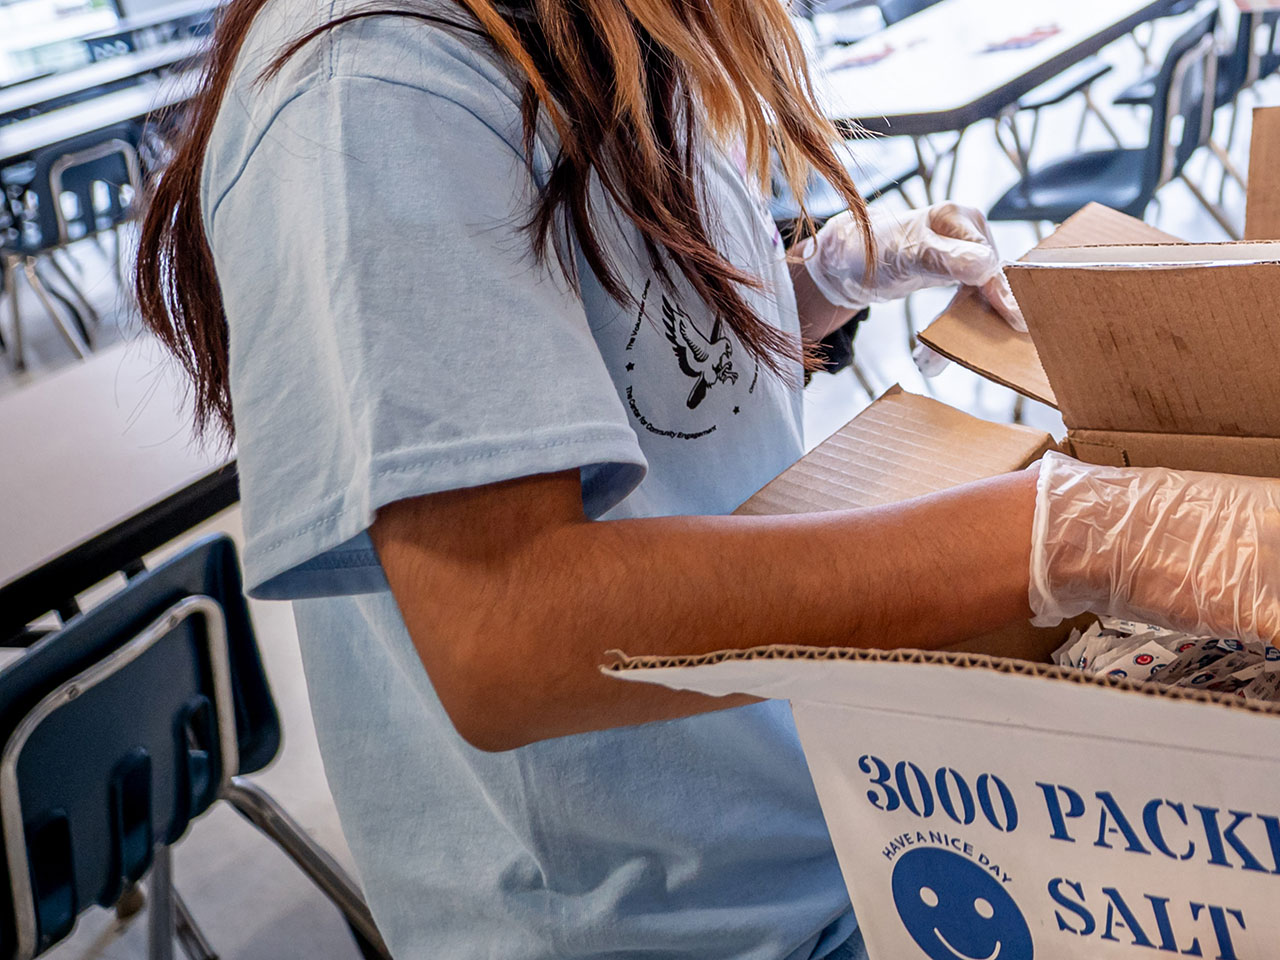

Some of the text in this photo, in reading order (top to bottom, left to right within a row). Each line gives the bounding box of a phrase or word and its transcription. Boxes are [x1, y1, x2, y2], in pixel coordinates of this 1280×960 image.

[626, 336, 636, 351] The
[626, 385, 718, 440] The Center for Community Engagement
[858, 754, 1018, 833] 3000
[882, 830, 1012, 883] HAVE A NICE DAY
[1047, 876, 1247, 960] SALT
